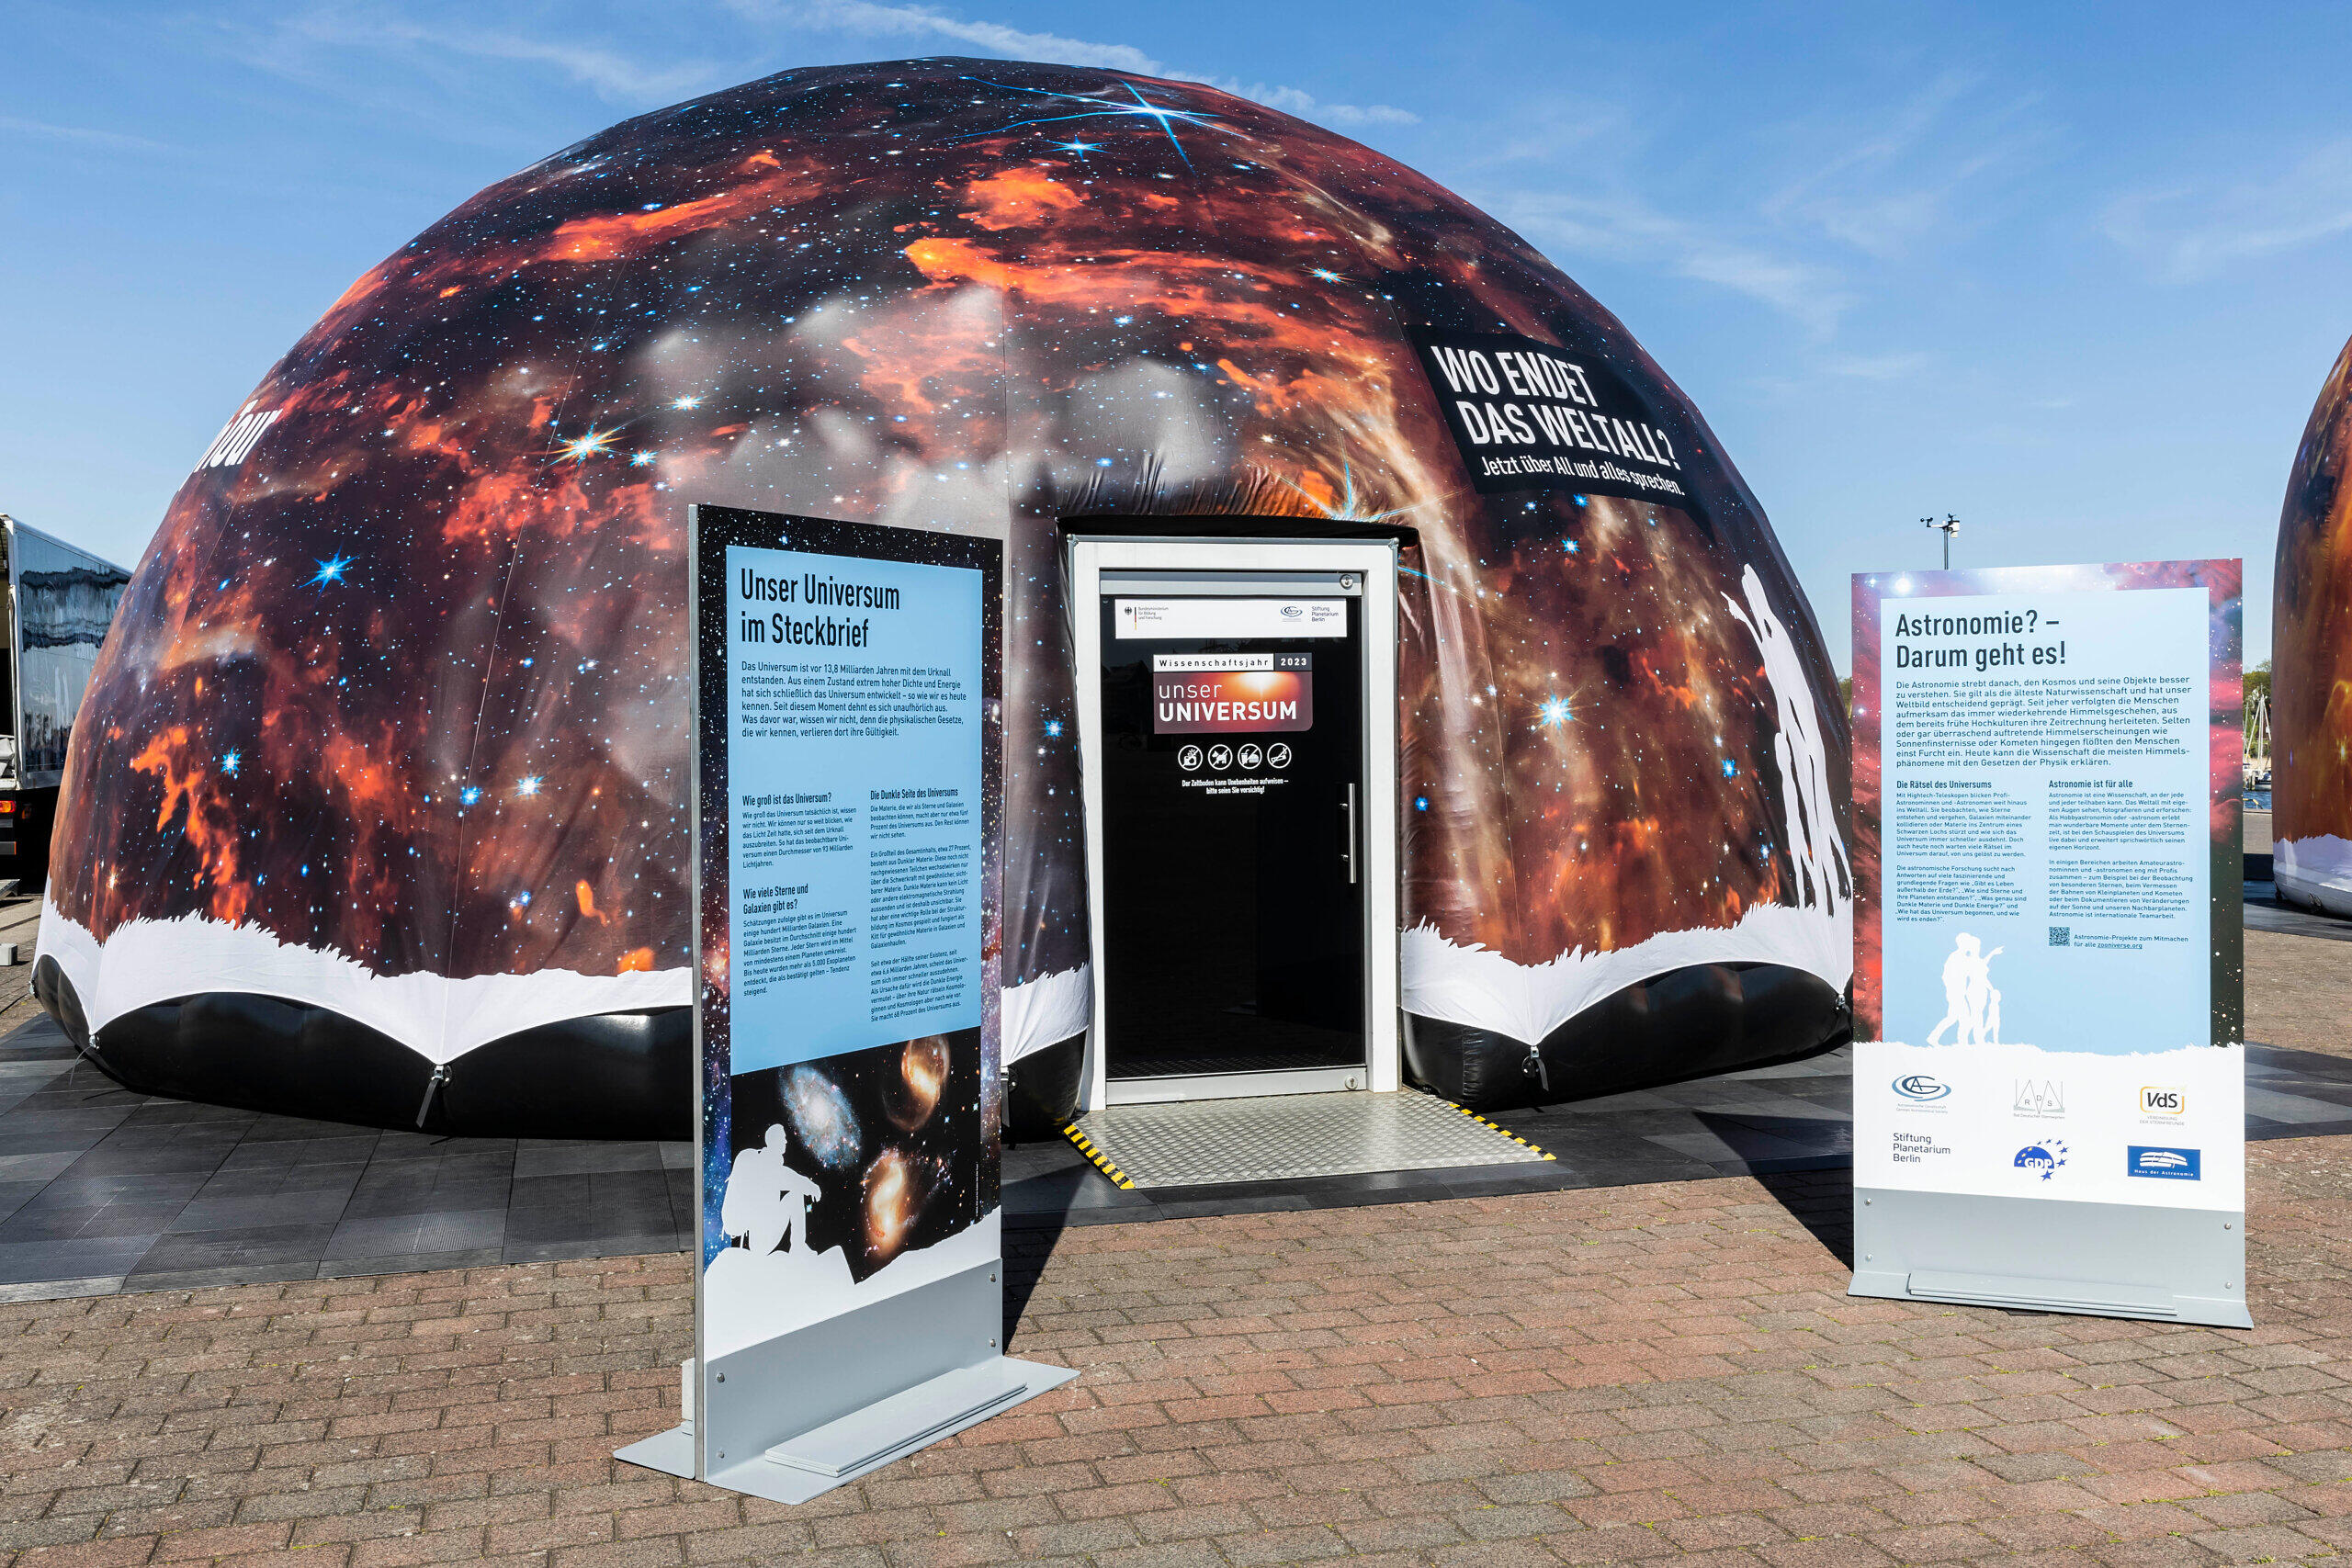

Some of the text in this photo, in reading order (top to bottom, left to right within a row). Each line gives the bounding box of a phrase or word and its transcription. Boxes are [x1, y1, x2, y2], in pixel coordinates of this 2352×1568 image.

[1430, 345, 1598, 407] WO ENDET
[1456, 400, 1680, 470] DAS WELTALL?
[1484, 456, 1685, 496] Jetzt über All und alles sprechen.
[741, 568, 899, 610] Unser Universum
[741, 610, 868, 648] im Steckbrief
[1894, 609, 2038, 637] Astronomie?
[1159, 657, 1306, 668] Wissenschaftsjahr 2023
[1896, 640, 2065, 671] Darum geht es!
[741, 660, 951, 677] Das Universum ist vor 13,8 Milliarden Jahren mit dem Urknall
[741, 674, 961, 691] entstanden. Aus einem Zustand extrem hoher Dichte und Energie
[1895, 681, 1910, 689] Die
[1911, 680, 1960, 689] Astronomie
[1961, 680, 1986, 688] strebt
[1988, 679, 2021, 687] danach,
[2041, 678, 2076, 686] Kosmos
[2078, 677, 2095, 685] und
[2097, 676, 2120, 685] seine
[2122, 676, 2157, 686] Objekte
[2159, 675, 2190, 683] besser
[741, 687, 754, 697] hat
[755, 687, 771, 697] sich
[773, 688, 812, 698] schließlich
[813, 689, 827, 699] das
[828, 689, 865, 699] Universum
[866, 690, 901, 700] entwickelt
[916, 691, 928, 700] wie
[928, 691, 940, 700] wir
[940, 693, 948, 701] es
[948, 691, 967, 701] heute
[1159, 683, 1223, 699] unser
[1906, 690, 1951, 699] verstehen.
[1968, 689, 1982, 699] gilt
[1984, 689, 1997, 697] als
[1998, 689, 2012, 697] die
[2045, 686, 2128, 696] Naturwissenschaft
[2130, 686, 2146, 694] und
[2148, 686, 2163, 694] hat
[1895, 696, 2179, 708] Weltbild entscheidend geprägt. Seit jeher verfolgten die Menschen
[1159, 700, 1296, 722] UNIVERSUM
[1182, 779, 1191, 787] Der
[1239, 785, 1265, 795] vorsichtig!
[1896, 780, 1992, 789] Die Rätsel des Universums
[2048, 779, 2133, 788] Astronomie ist für alle
[741, 791, 831, 808] Wie groß ist das Universum?
[870, 787, 958, 800] Die Dunkle Seite des Universums
[742, 883, 808, 899] Wie viele Sterne und
[742, 898, 797, 915] Galaxien gibt es?
[2074, 933, 2138, 942] Astronomie-Projekte
[2147, 1092, 2178, 1108] VdS
[1893, 1133, 1931, 1145] Stiftung
[1893, 1144, 1951, 1154] Planetarium
[1893, 1154, 1920, 1163] Berlin
[2024, 1157, 2052, 1169] GDP
